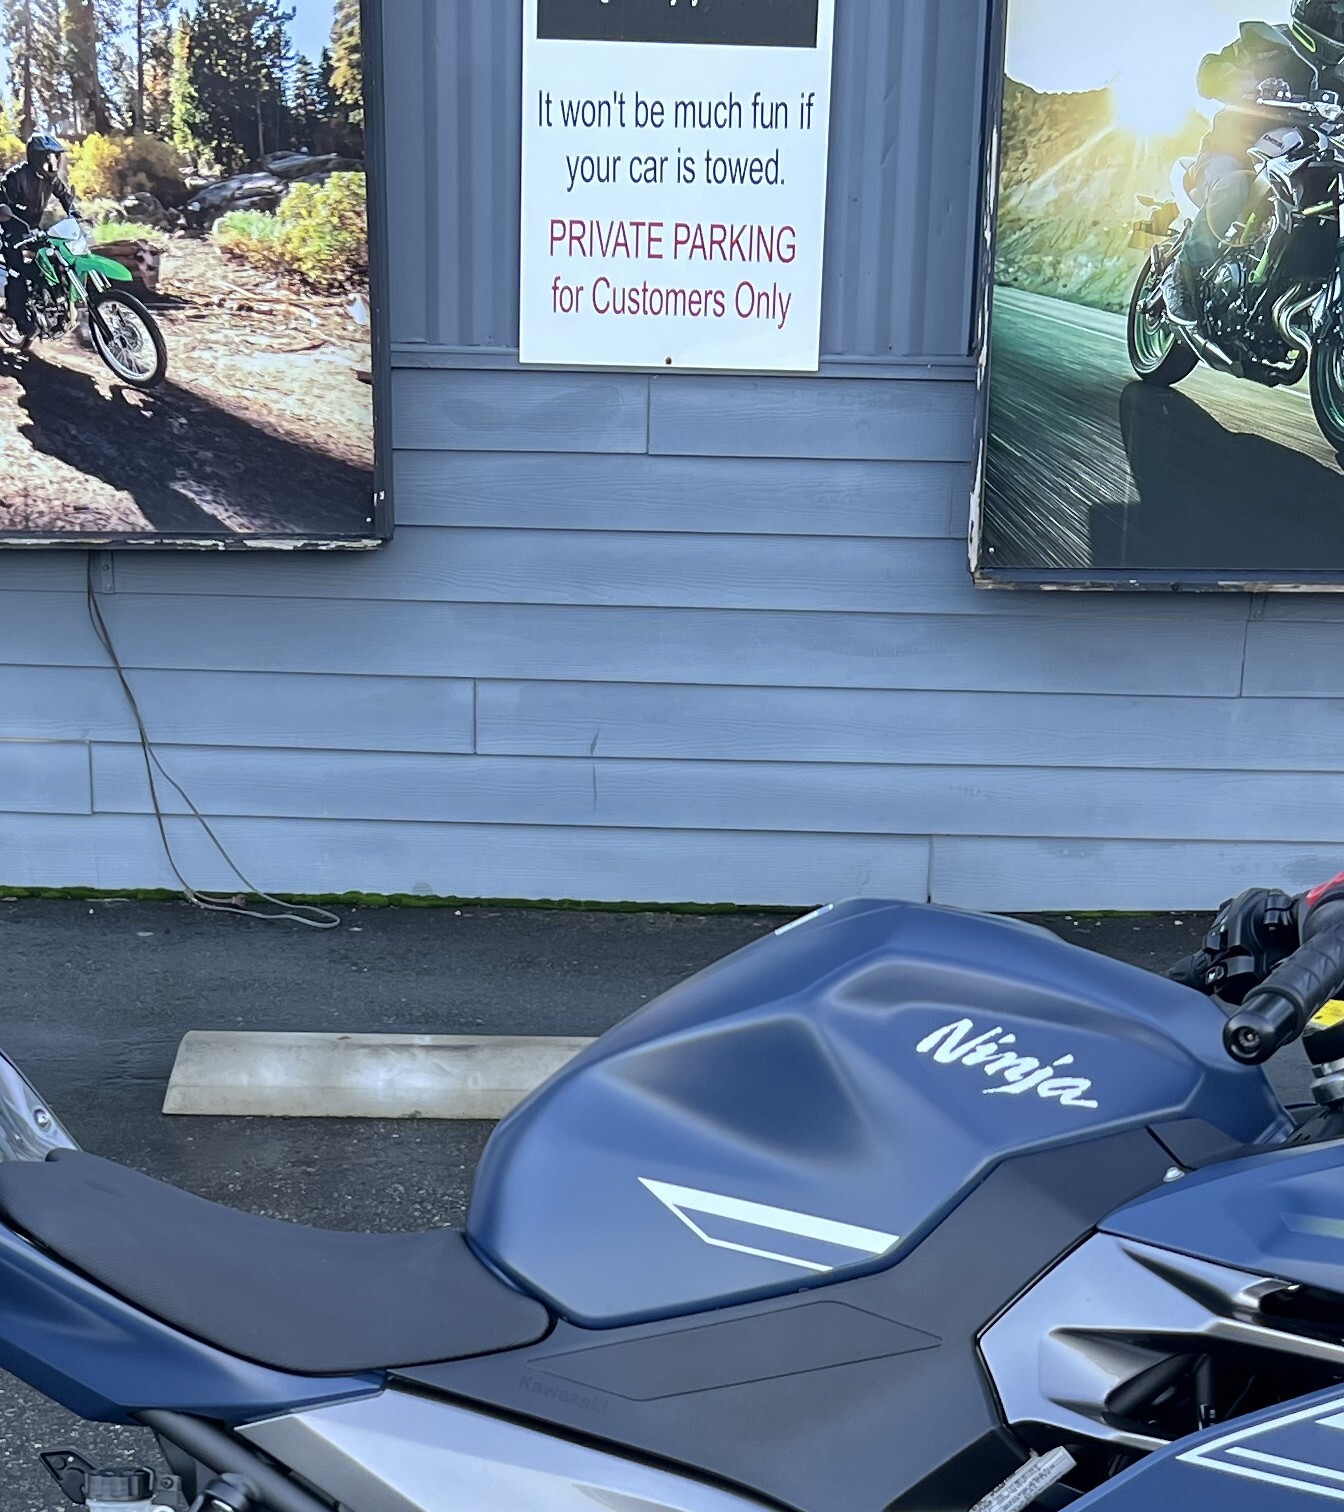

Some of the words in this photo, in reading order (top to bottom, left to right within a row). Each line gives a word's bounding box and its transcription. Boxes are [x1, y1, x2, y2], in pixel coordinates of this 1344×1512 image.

[538, 90, 553, 128] It
[560, 91, 626, 128] won't
[635, 91, 665, 129] be
[674, 92, 743, 129] much
[752, 92, 788, 130] fun
[800, 92, 816, 130] if
[566, 154, 621, 192] your
[629, 154, 669, 184] car
[677, 147, 696, 184] is
[705, 148, 786, 186] towed.
[549, 219, 664, 260] PRIVATE
[674, 222, 797, 264] PARKING
[552, 276, 584, 314] for
[592, 276, 726, 318] Customers
[735, 280, 792, 330] Only
[916, 1018, 1099, 1108] Ninja
